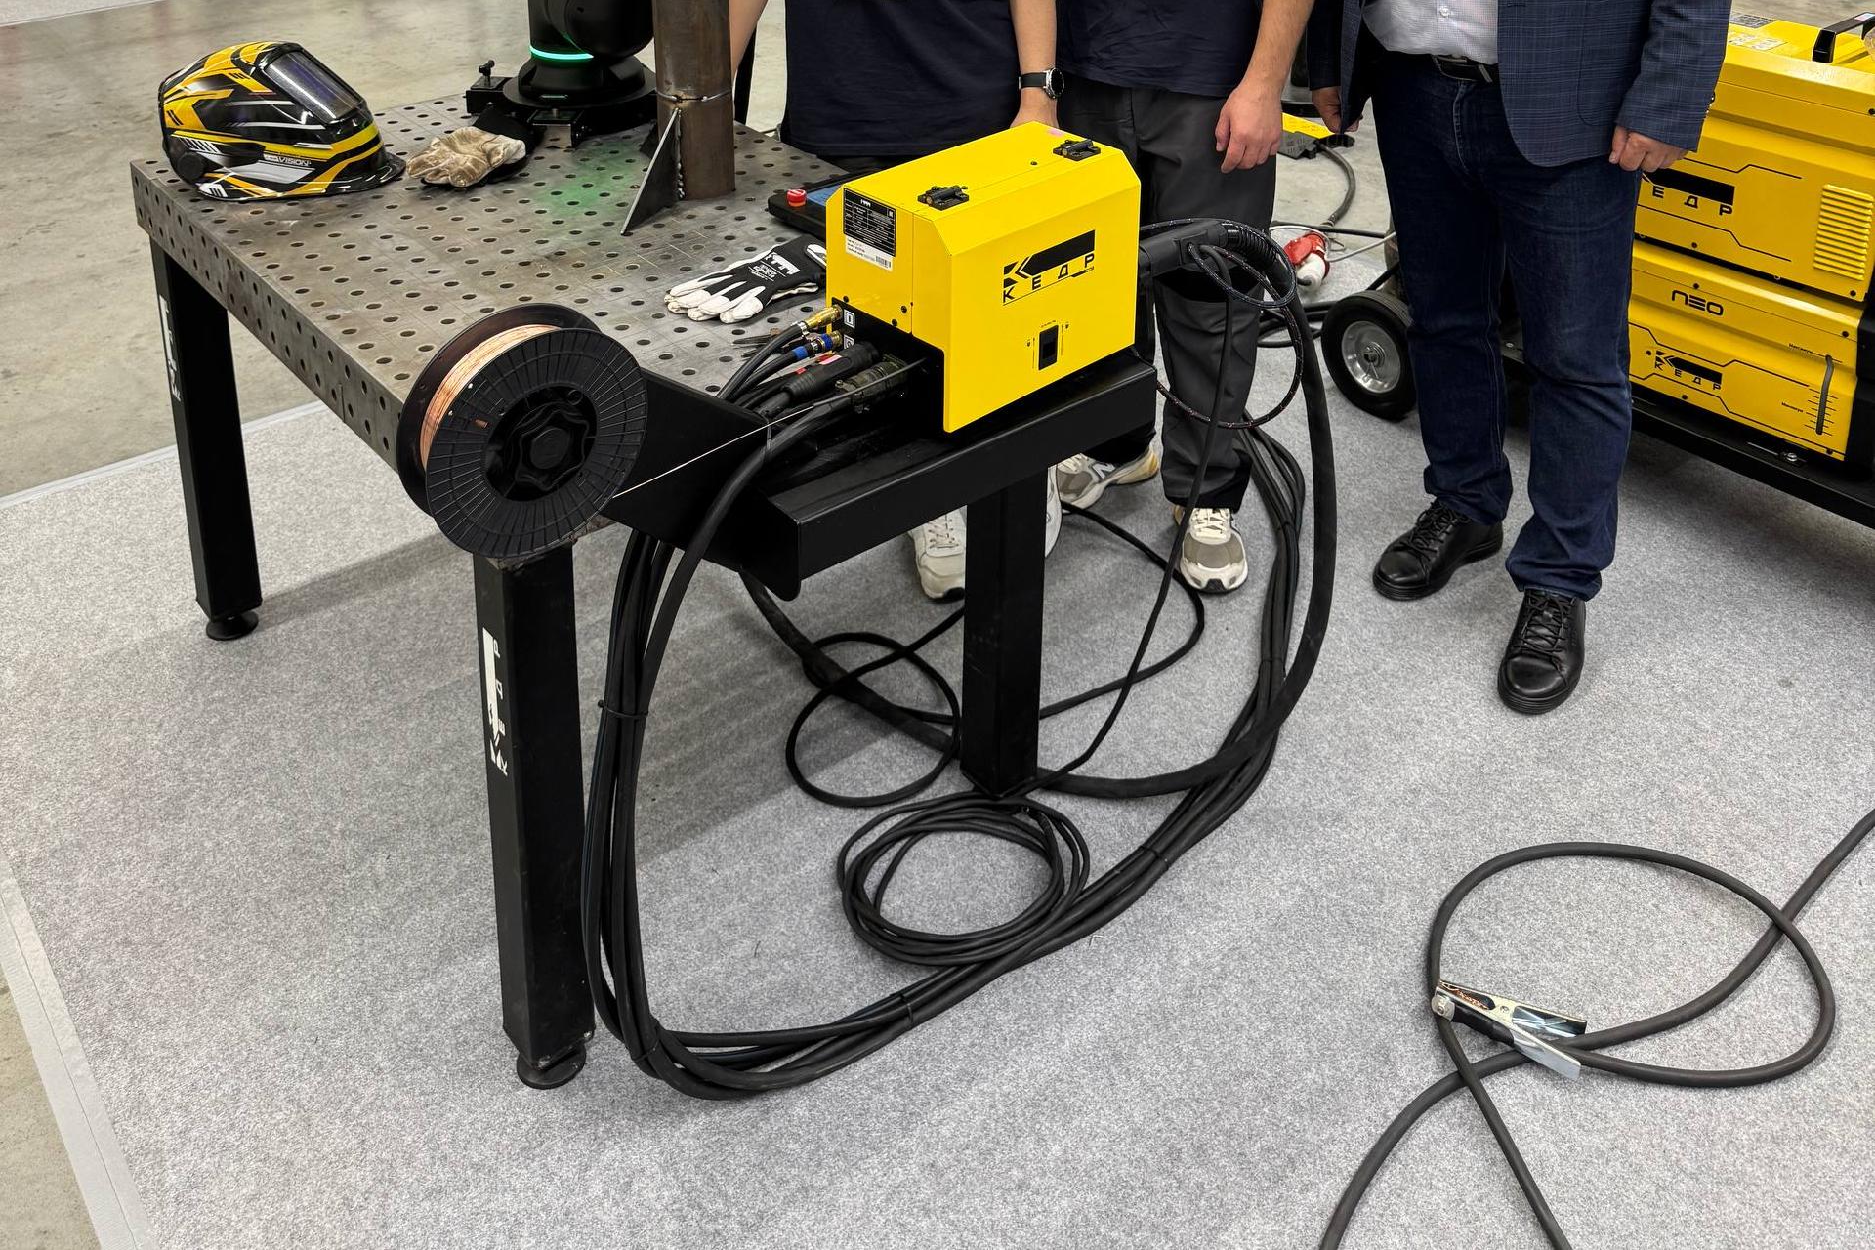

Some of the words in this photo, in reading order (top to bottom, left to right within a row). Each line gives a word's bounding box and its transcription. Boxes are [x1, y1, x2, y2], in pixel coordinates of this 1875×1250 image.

[1652, 186, 1733, 216] ЕДР
[1003, 253, 1095, 304] КЕДР
[1655, 361, 1722, 391] КЕДР
